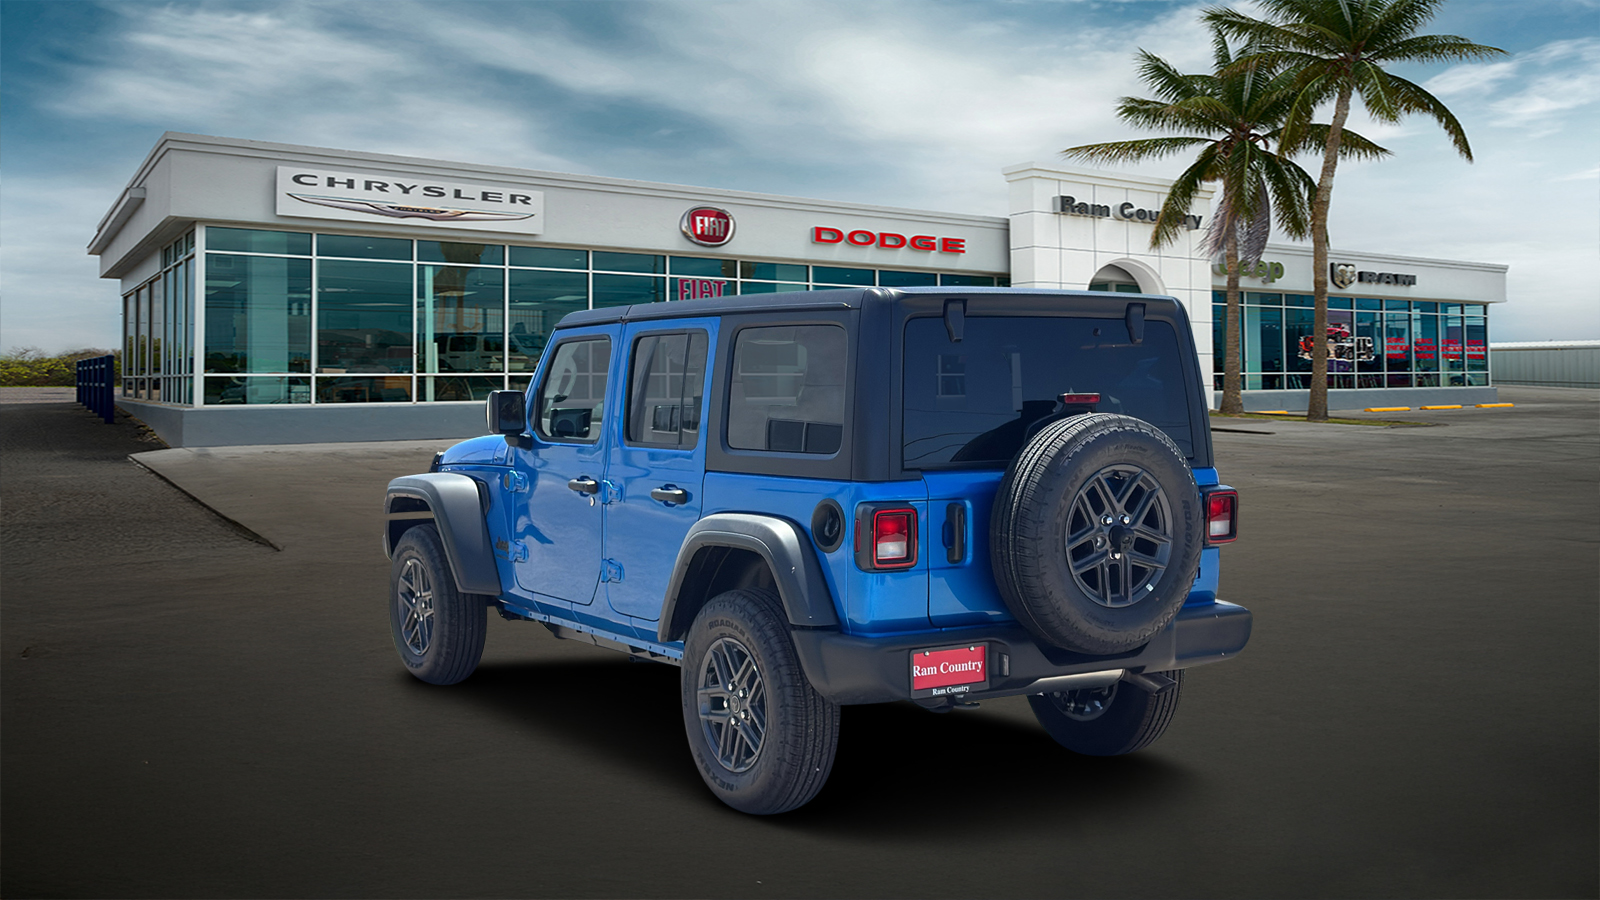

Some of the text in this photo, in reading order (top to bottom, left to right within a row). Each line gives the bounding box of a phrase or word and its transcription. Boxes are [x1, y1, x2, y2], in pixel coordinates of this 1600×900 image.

[291, 173, 532, 206] CHRYSLER
[1054, 195, 1203, 230] Ram Coury
[695, 215, 728, 237] FIAT
[812, 226, 966, 254] DODGE
[679, 278, 727, 301] FIAT
[1358, 271, 1416, 286] RAM
[913, 660, 983, 677] Ram Country
[947, 685, 970, 693] Country
